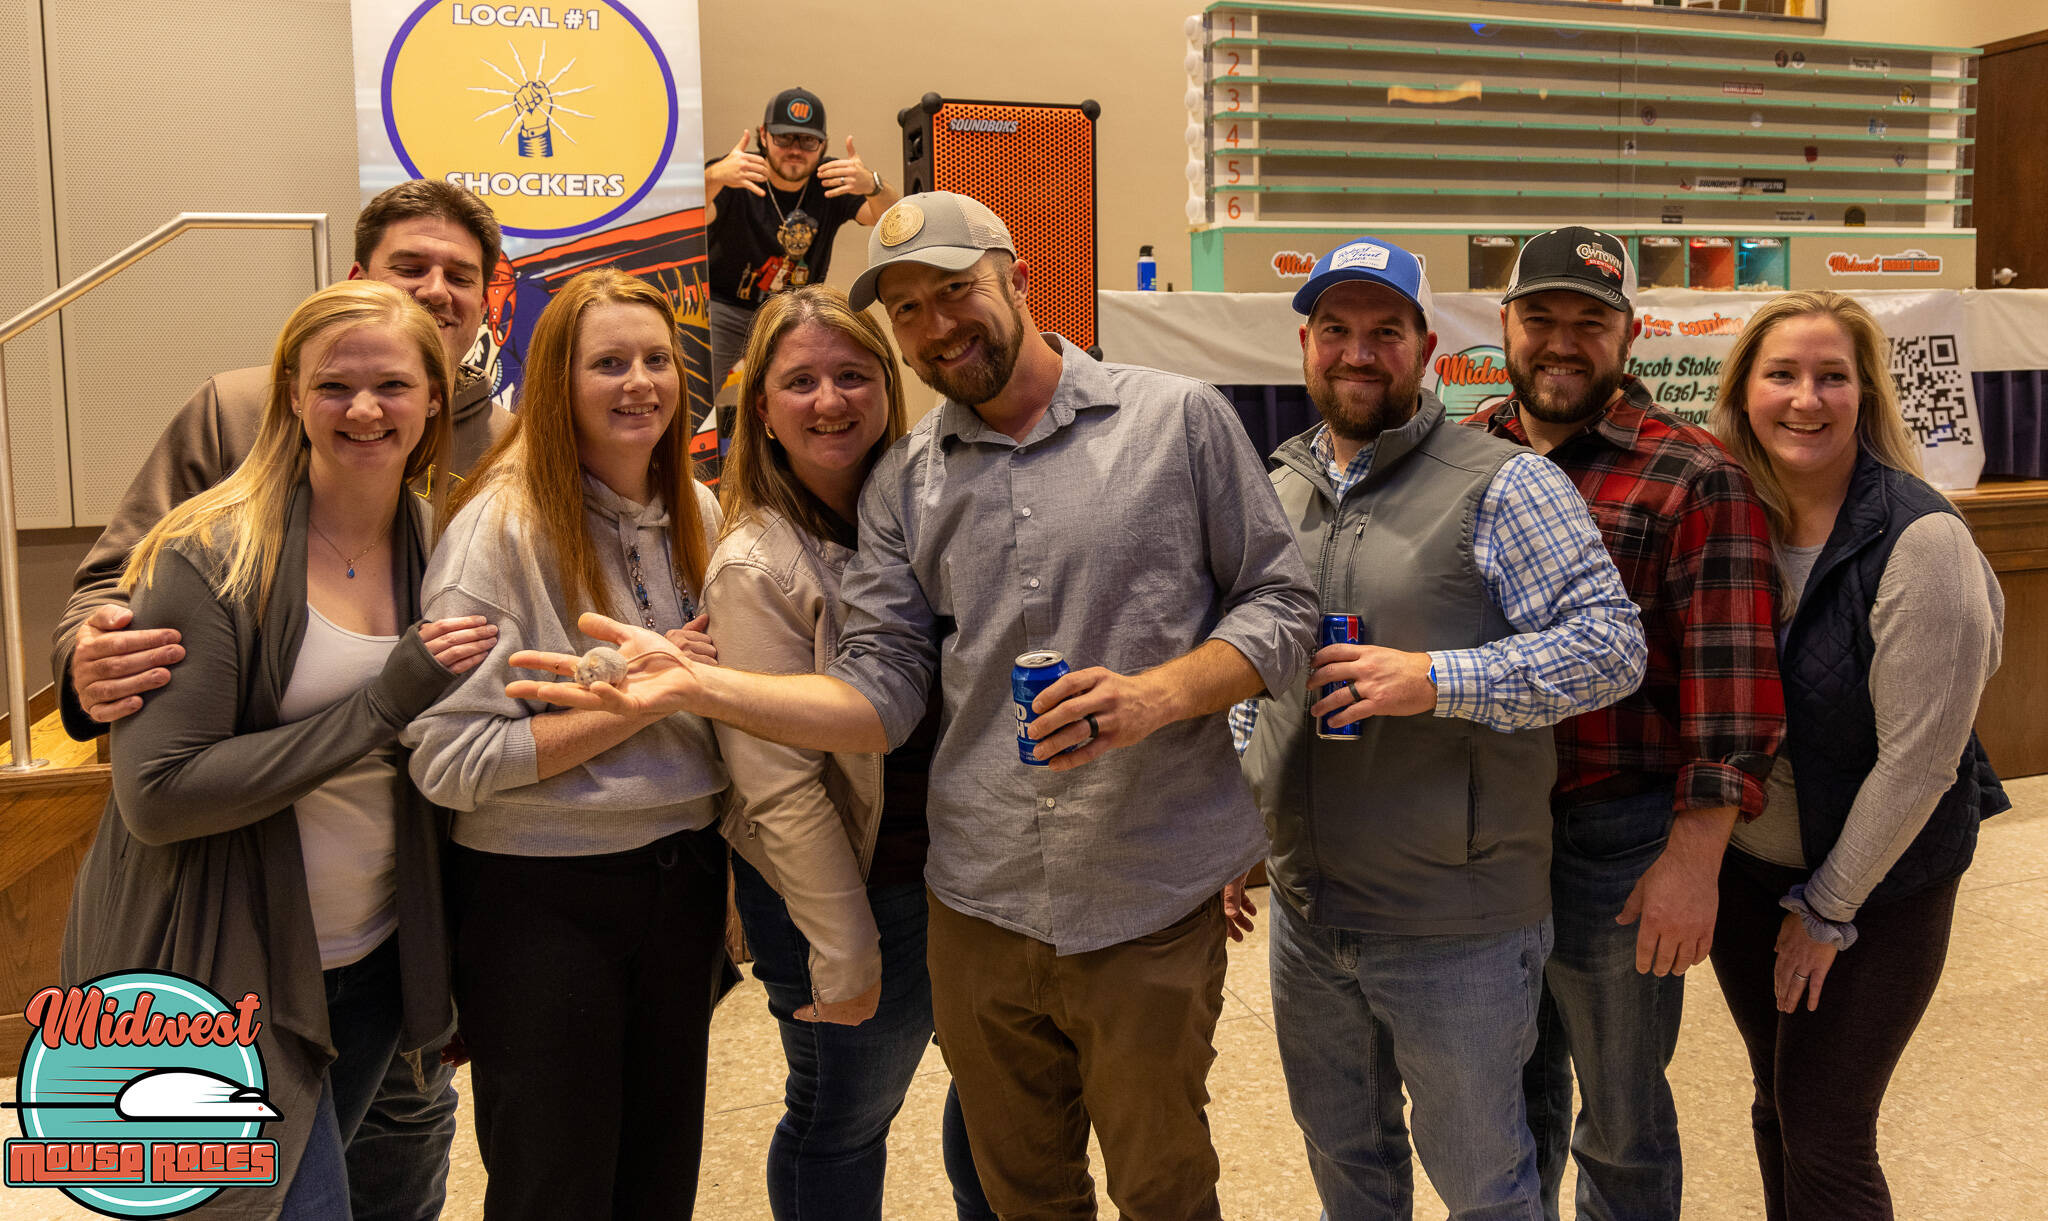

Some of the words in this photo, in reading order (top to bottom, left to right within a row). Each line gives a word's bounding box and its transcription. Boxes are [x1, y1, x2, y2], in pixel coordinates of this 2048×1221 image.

[453, 4, 558, 29] LOCAL
[563, 9, 600, 30] #1
[1228, 16, 1236, 39] 1
[1227, 52, 1240, 76] 2
[1227, 88, 1240, 112] 3
[950, 118, 1019, 133] SOUNDBOKS
[1226, 124, 1239, 148] 4
[446, 171, 625, 197] SHOCKERS
[1227, 160, 1240, 184] 5
[1227, 196, 1241, 220] 6
[1434, 353, 1512, 387] Midw
[1628, 357, 1672, 377] Jacob
